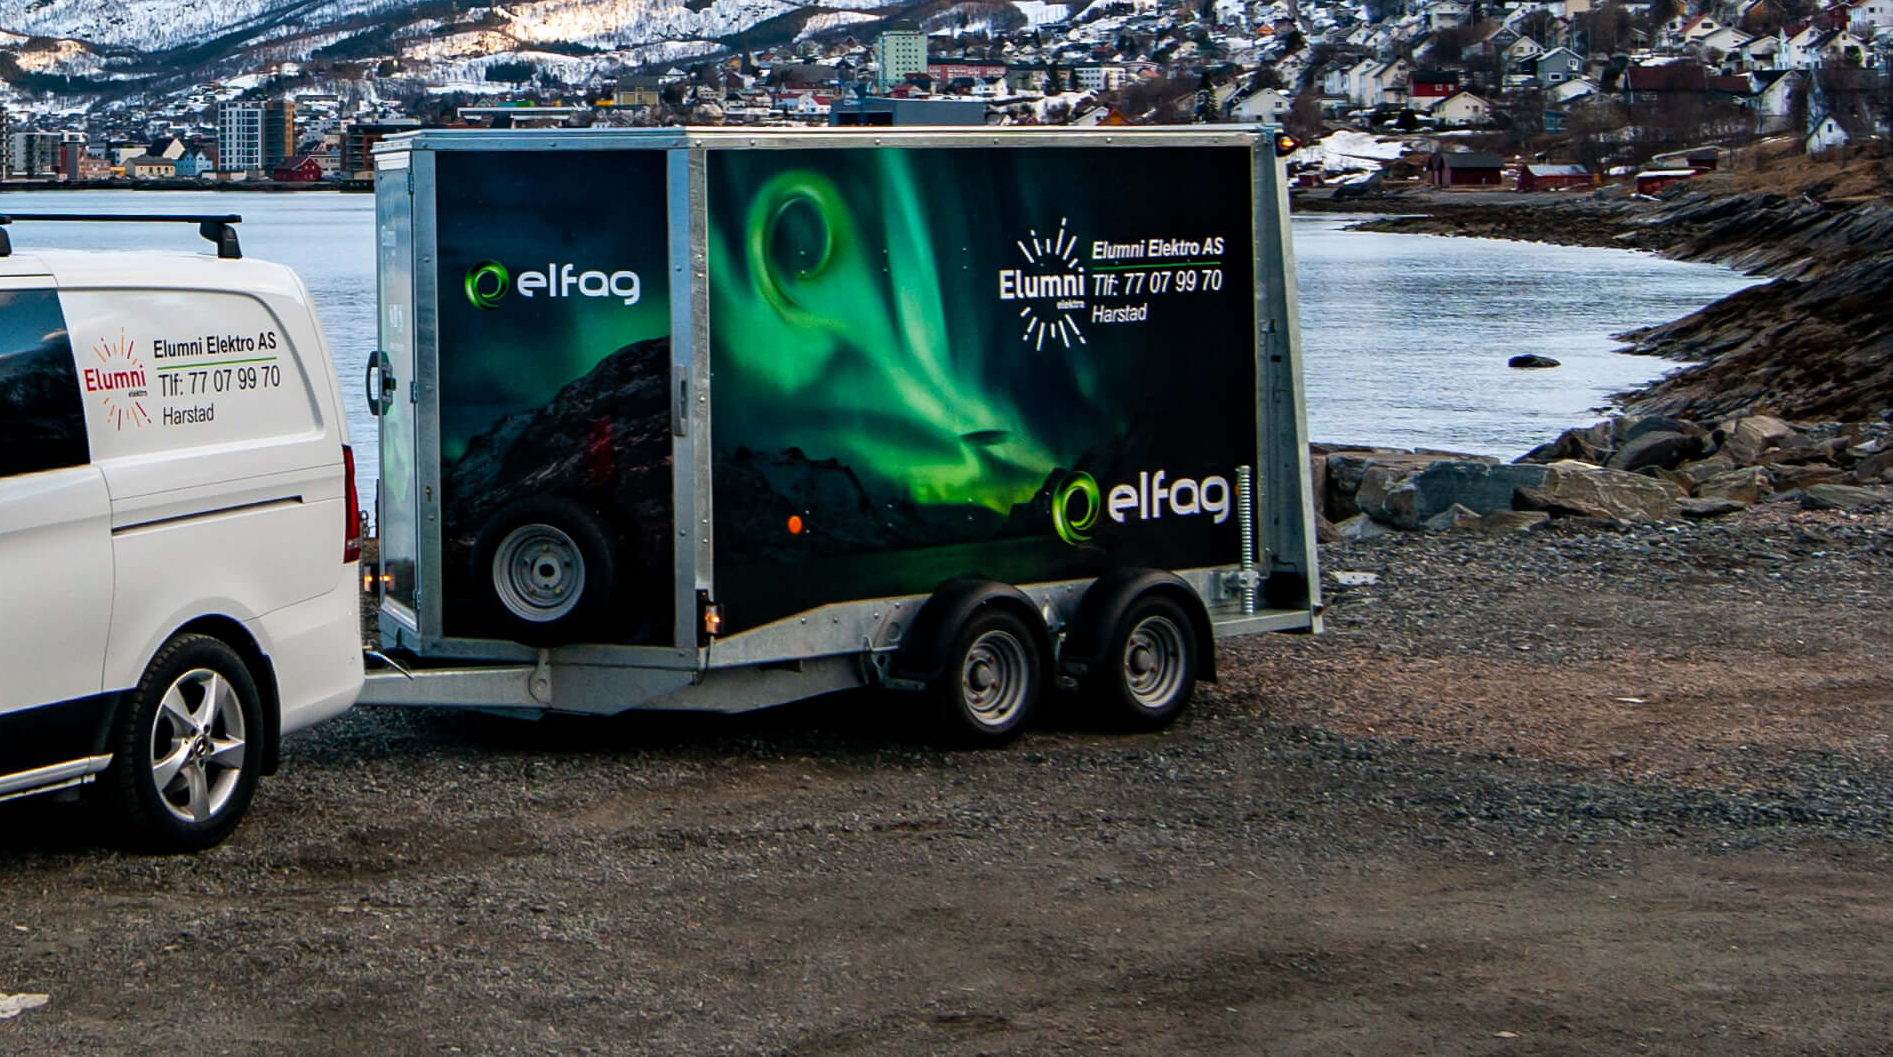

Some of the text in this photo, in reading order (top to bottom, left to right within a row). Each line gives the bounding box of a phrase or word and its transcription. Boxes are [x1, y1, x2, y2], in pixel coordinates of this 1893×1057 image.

[1092, 236, 1225, 259] Elumni Elektro AS
[517, 262, 641, 306] elfag
[999, 266, 1085, 299] Elumni
[1092, 269, 1223, 296] Tlf: 77 07 99 70
[1091, 303, 1148, 323] Harstad
[153, 331, 277, 359] Elumni Elektro AS
[84, 364, 147, 392] Elumni
[158, 365, 281, 397] Tlf: 77 07 99 70
[162, 403, 215, 425] Harstad
[1108, 469, 1231, 524] elfag
